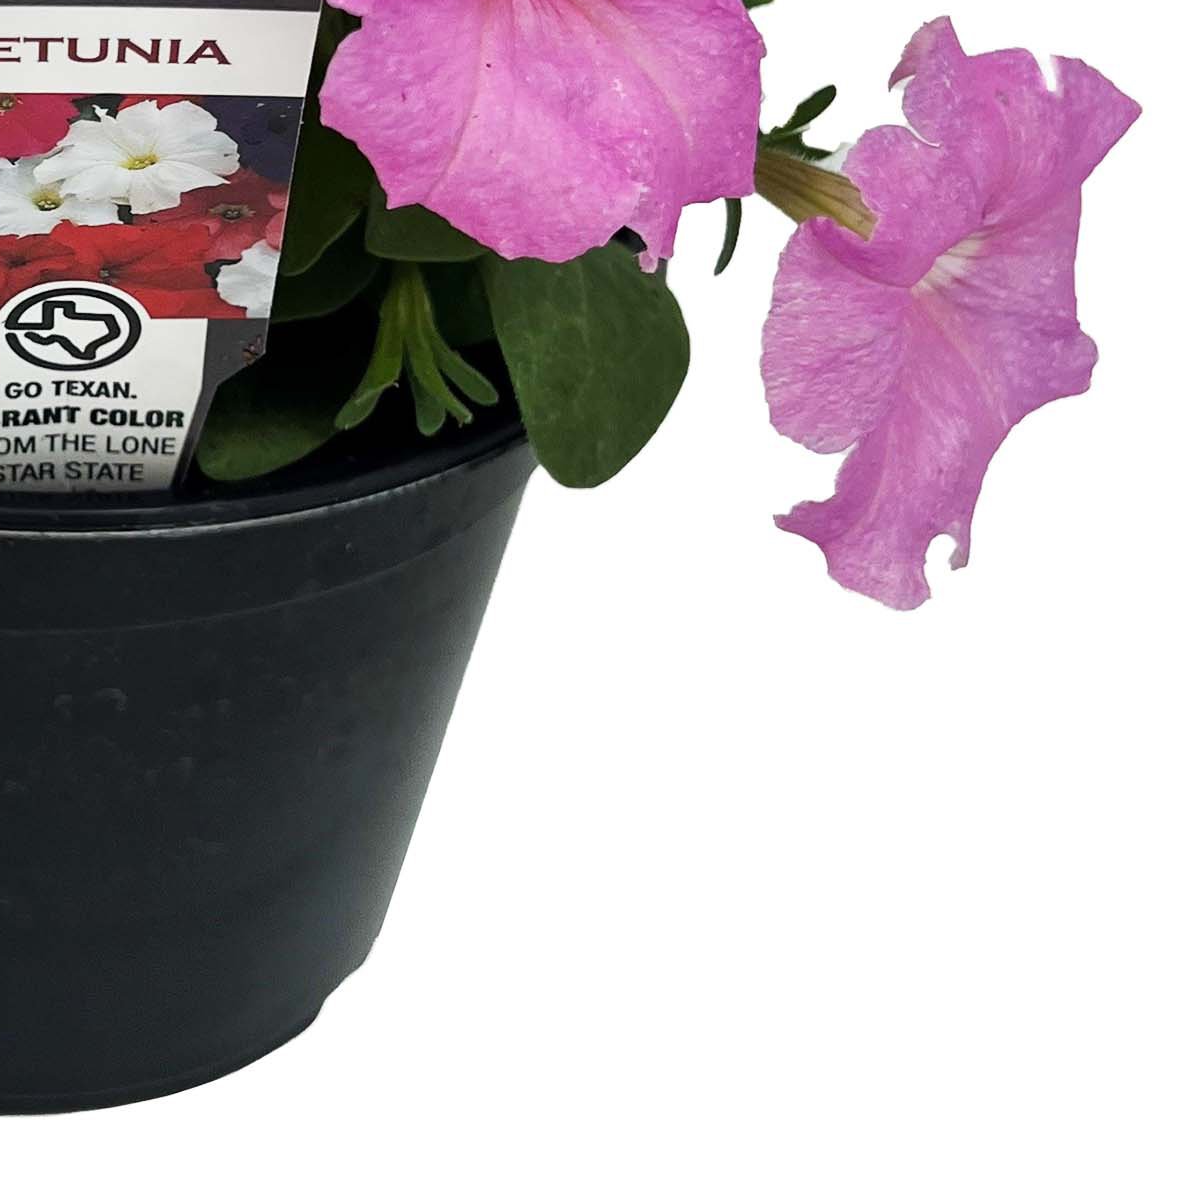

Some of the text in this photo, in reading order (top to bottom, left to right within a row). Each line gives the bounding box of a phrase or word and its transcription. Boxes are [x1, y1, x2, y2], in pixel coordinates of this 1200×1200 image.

[4, 380, 138, 400] GO TEXAN.
[89, 408, 186, 428] COLOR
[44, 432, 97, 455] THE
[105, 435, 177, 456] LONE
[64, 460, 145, 483] STATE
